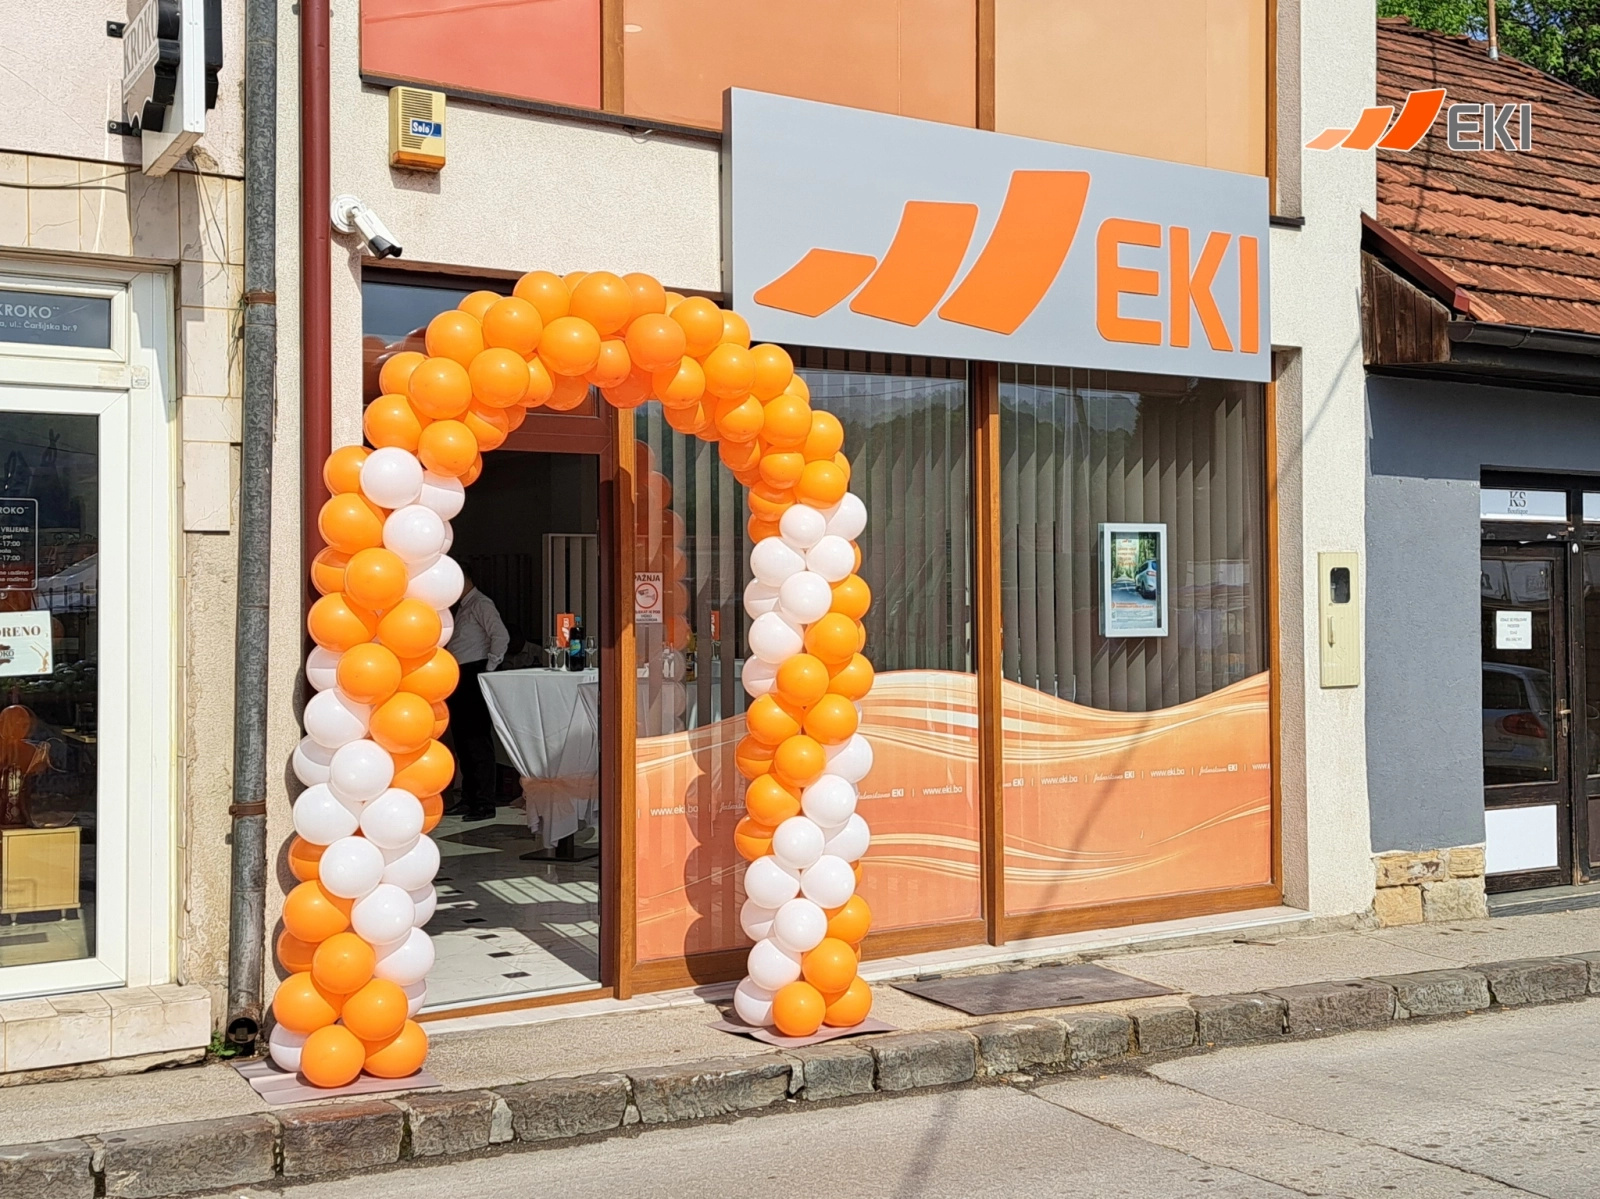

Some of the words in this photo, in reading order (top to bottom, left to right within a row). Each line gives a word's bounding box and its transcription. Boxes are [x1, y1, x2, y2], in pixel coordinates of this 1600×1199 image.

[413, 122, 430, 134] Solo
[1096, 217, 1259, 354] EKI
[1509, 491, 1527, 508] KS
[1507, 507, 1528, 516] Boutique
[0, 625, 41, 637] RENO
[1012, 778, 1024, 787] EKI
[1041, 775, 1079, 785] www.eki.ba
[1124, 770, 1135, 779] EKI
[1150, 767, 1185, 778] www.eki.ba
[1227, 763, 1238, 772] EKI
[892, 788, 904, 797] EKI
[923, 785, 963, 795] www.eki.ba
